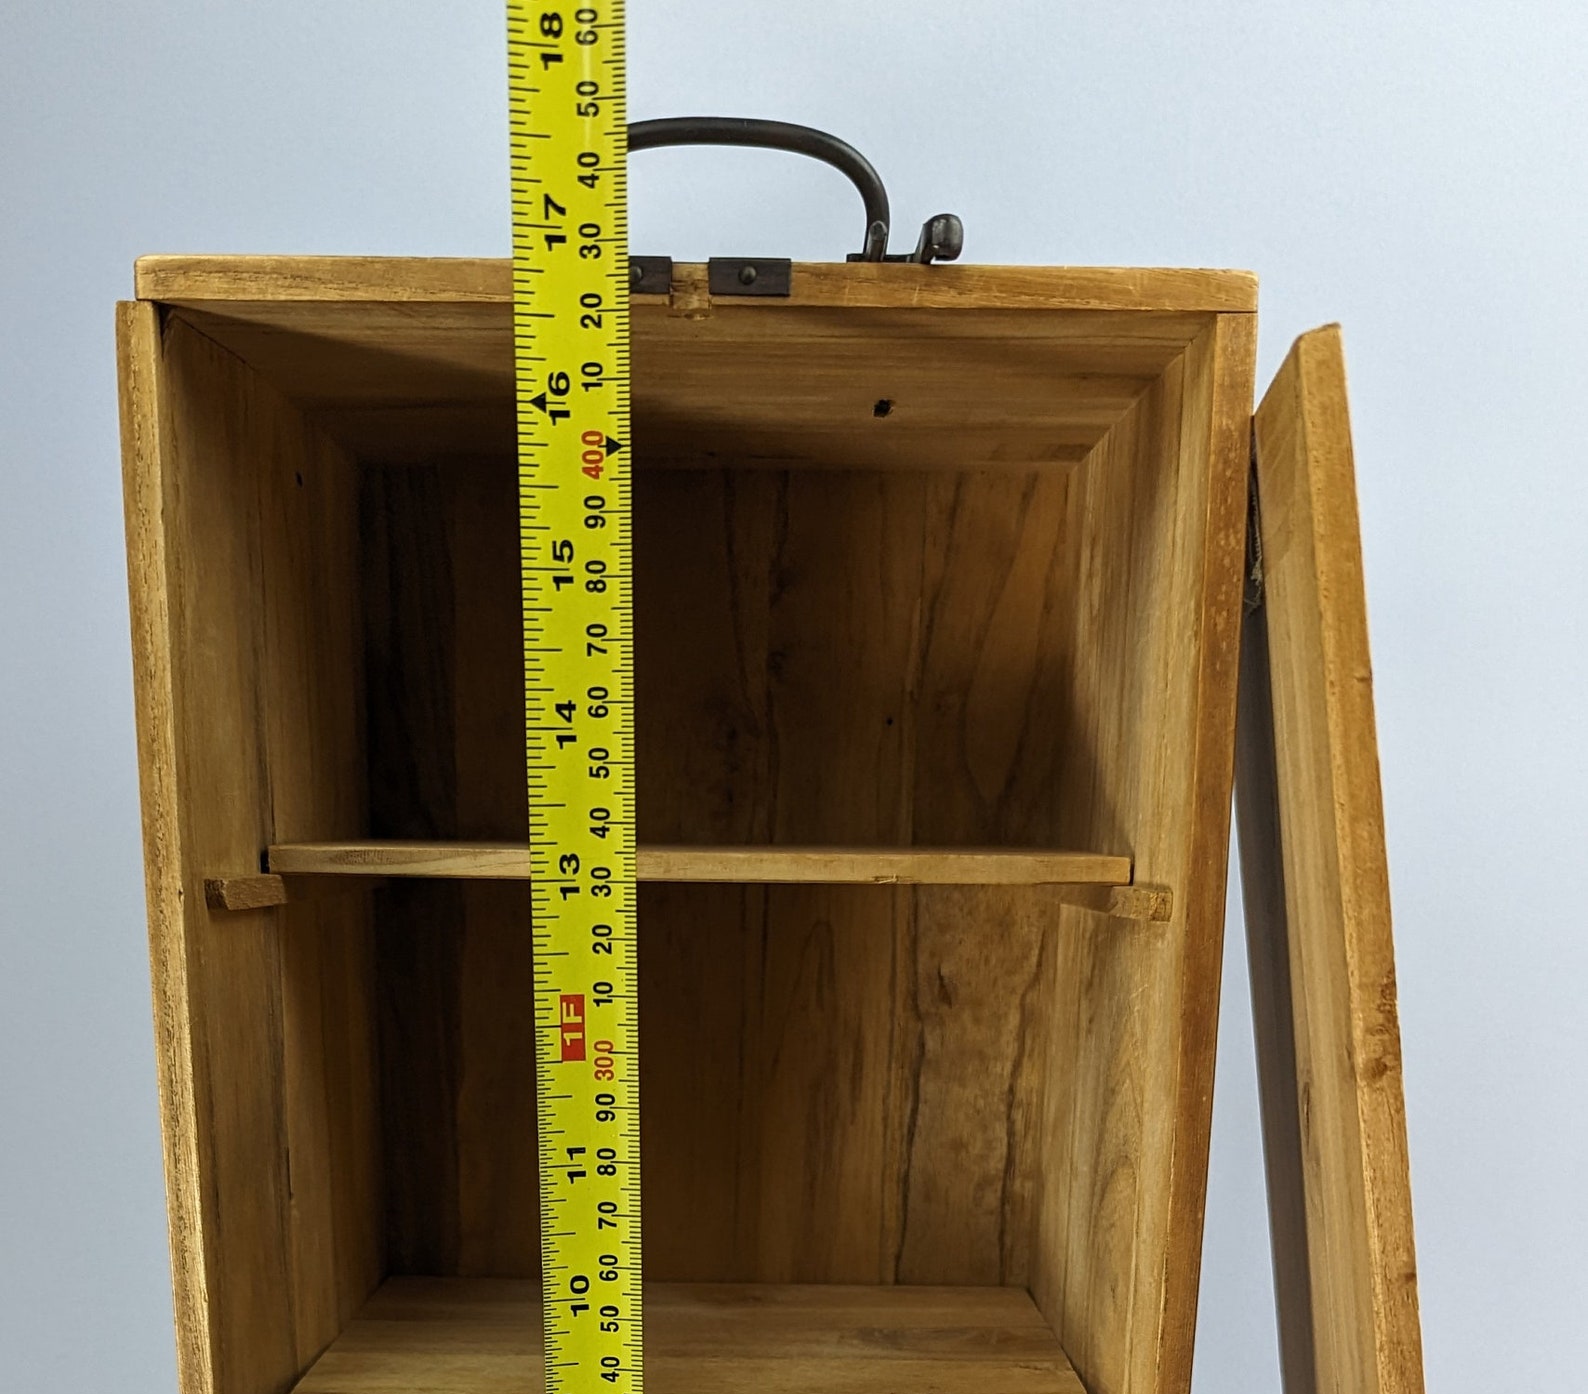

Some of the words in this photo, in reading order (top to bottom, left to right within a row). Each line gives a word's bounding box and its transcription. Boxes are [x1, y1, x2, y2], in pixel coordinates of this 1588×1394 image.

[540, 12, 563, 71] 18
[575, 8, 599, 46] 60
[576, 80, 600, 117] 50
[577, 152, 600, 189] 40
[543, 193, 567, 251] 17
[578, 222, 601, 259] 30
[580, 293, 602, 329] 20
[581, 361, 603, 392] 10
[548, 371, 570, 426] 16
[581, 430, 604, 480] 400
[583, 495, 606, 529] 90
[552, 539, 574, 592] 15
[585, 560, 607, 594] 80
[586, 623, 608, 657] 70
[587, 686, 609, 719] 60
[555, 700, 577, 750] 14
[588, 747, 610, 779] 50
[589, 807, 611, 839] 40
[559, 853, 580, 901] 13
[590, 866, 611, 897] 30
[591, 924, 613, 955] 20
[593, 981, 614, 1007] 10
[562, 1001, 583, 1047] 1F
[594, 1039, 614, 1081] 300
[595, 1093, 616, 1122] 90
[566, 1147, 586, 1184] 11
[596, 1147, 617, 1177] 80
[597, 1201, 618, 1230] 70
[598, 1254, 619, 1282] 60
[569, 1274, 590, 1317] 10
[599, 1304, 620, 1333] 50
[600, 1356, 620, 1382] 40
